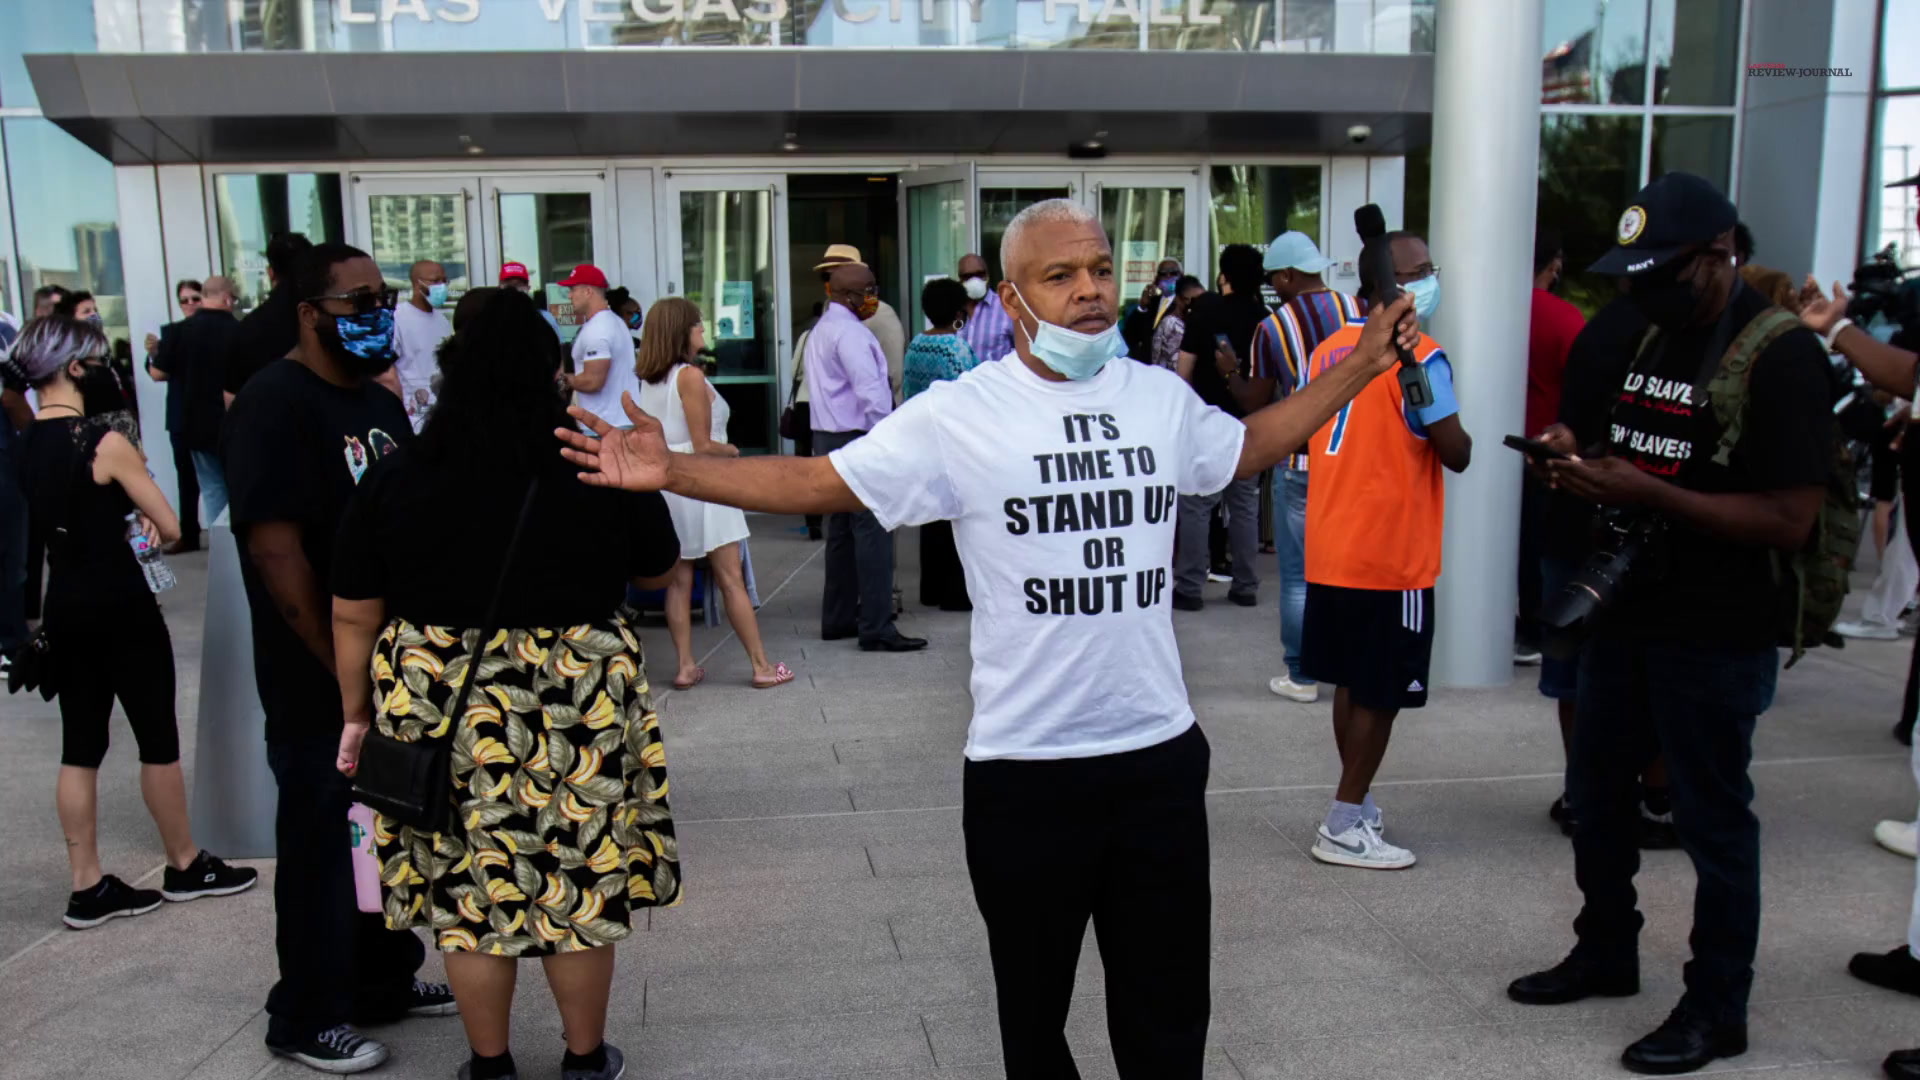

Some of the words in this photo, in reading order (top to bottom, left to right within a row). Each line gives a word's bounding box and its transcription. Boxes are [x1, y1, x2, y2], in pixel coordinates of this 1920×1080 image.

[1063, 413, 1121, 444] IT'S
[1630, 430, 1692, 459] SLAVES
[1033, 449, 1114, 484] TIME
[1117, 445, 1156, 476] TO
[1003, 489, 1133, 536] STAND
[1144, 485, 1175, 524] UP
[1083, 537, 1125, 570] OR
[1023, 574, 1128, 616] SHUT
[1136, 567, 1166, 609] UP
